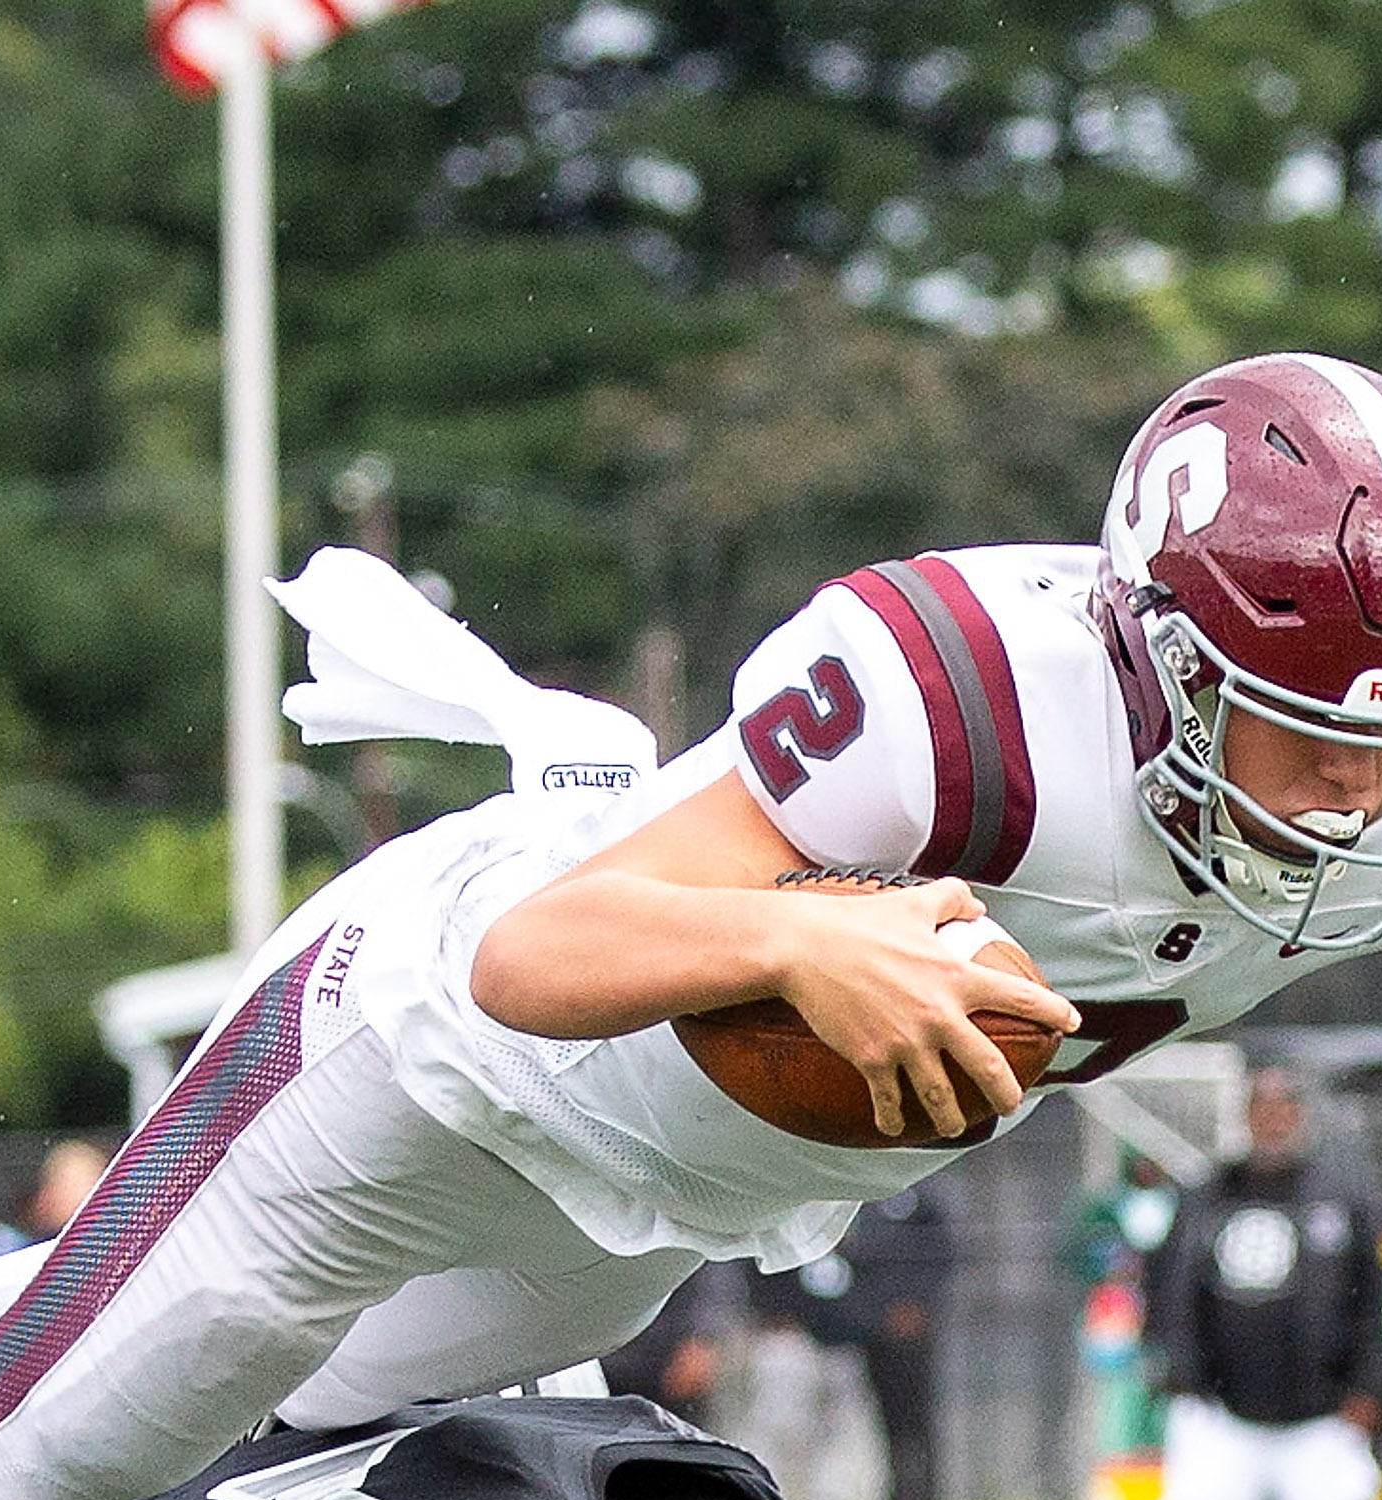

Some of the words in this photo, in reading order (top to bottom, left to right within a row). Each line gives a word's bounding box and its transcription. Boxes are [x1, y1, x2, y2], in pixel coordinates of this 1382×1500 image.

[1107, 421, 1229, 582] S
[550, 770, 631, 788] BATTLE
[738, 653, 866, 806] 2
[317, 924, 365, 1008] STATE
